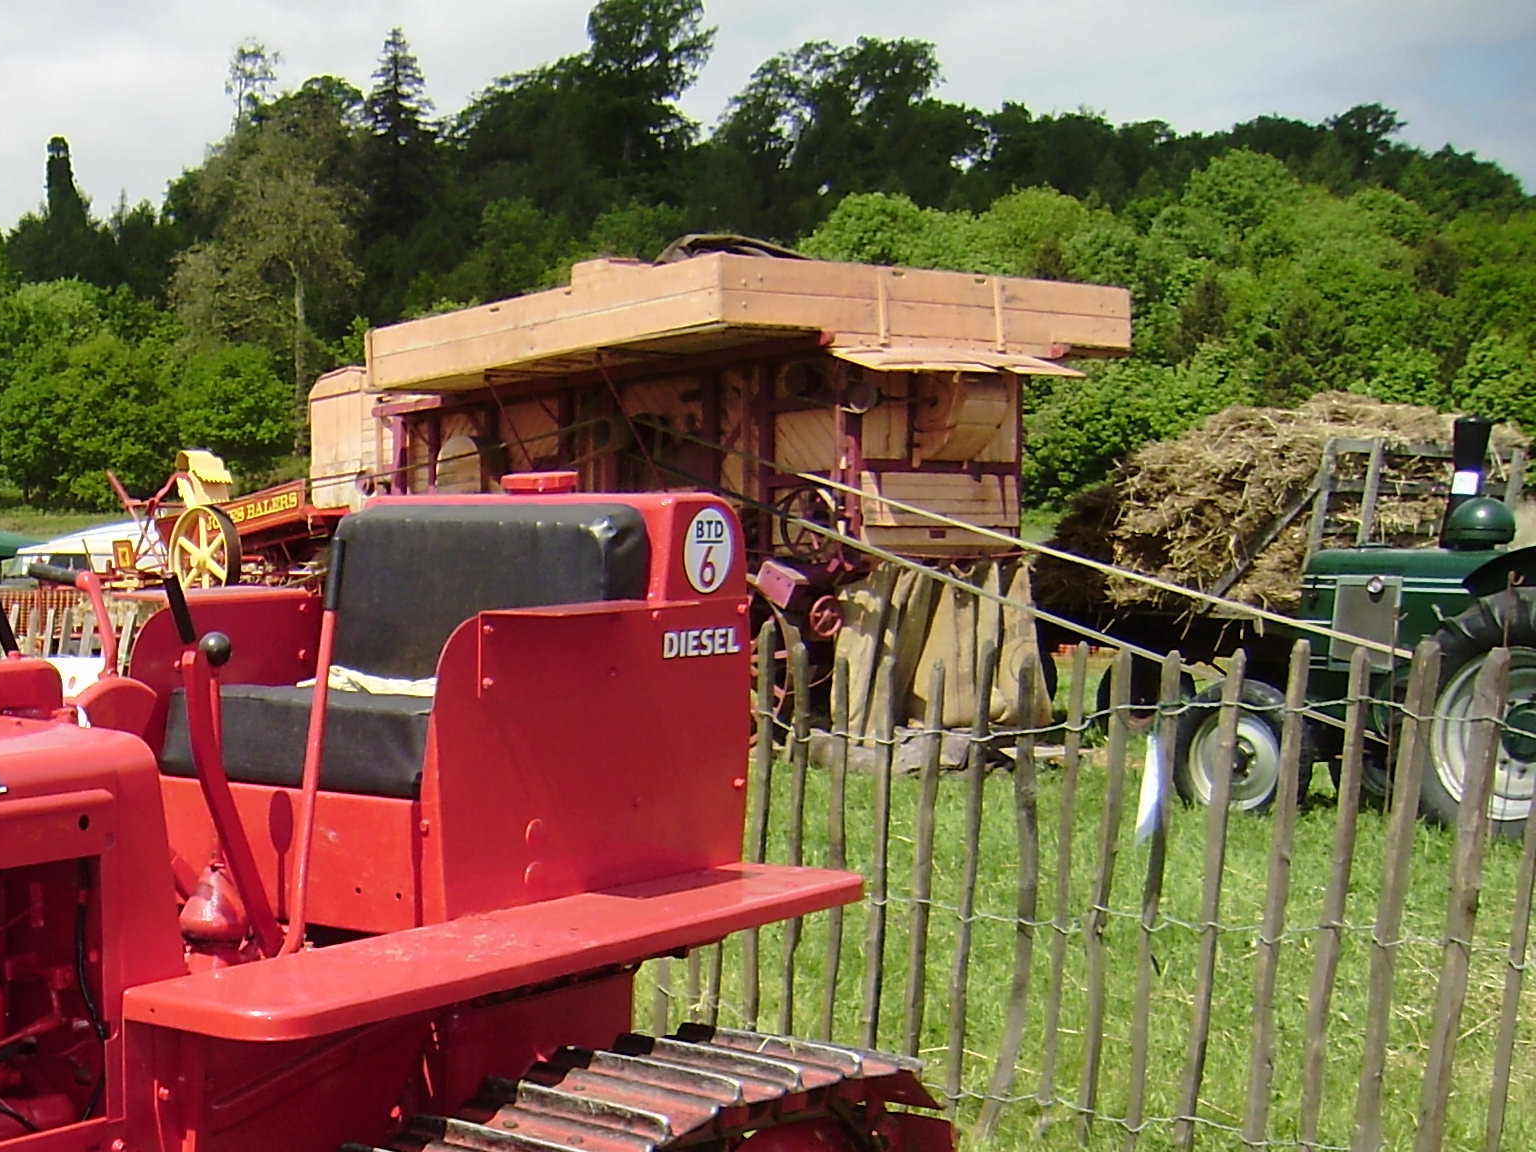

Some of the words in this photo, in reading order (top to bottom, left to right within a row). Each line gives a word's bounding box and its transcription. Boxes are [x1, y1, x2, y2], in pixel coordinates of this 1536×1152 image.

[207, 506, 245, 531] JOES
[247, 492, 298, 519] BALERS
[695, 520, 724, 539] BTD
[699, 545, 716, 589] 6
[663, 628, 741, 659] DIESEL
